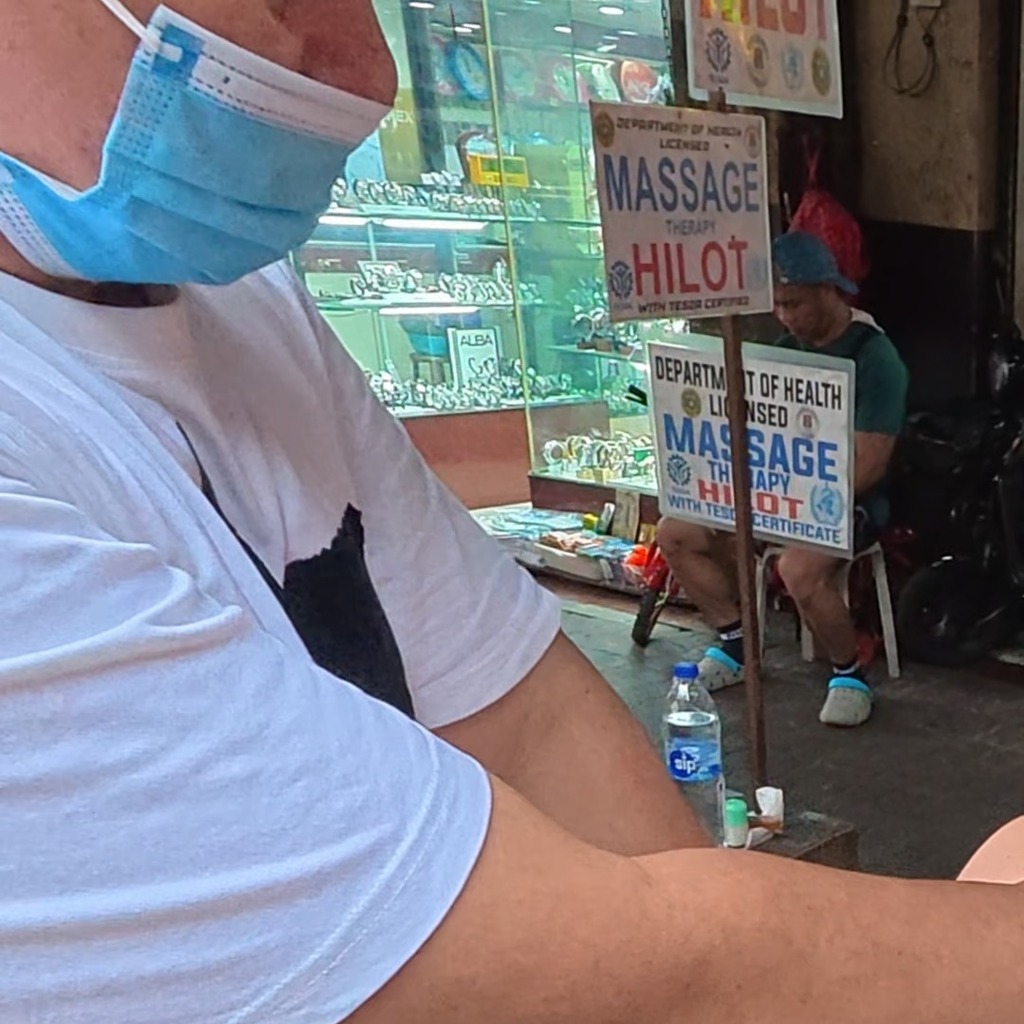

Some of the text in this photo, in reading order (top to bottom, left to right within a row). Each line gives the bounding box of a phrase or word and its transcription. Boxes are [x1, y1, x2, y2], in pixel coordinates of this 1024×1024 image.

[603, 153, 760, 213] MASSAGE
[665, 219, 716, 237] THERAPY
[631, 239, 749, 296] HILOT
[638, 300, 666, 314] WITH
[654, 355, 842, 411] DEPARTMT OF HEALTH
[709, 393, 789, 429] LINSED
[707, 459, 791, 496] THAPY
[667, 494, 702, 513] WITH
[752, 515, 841, 545] CERTIFICATE
[697, 478, 805, 520] HIOT
